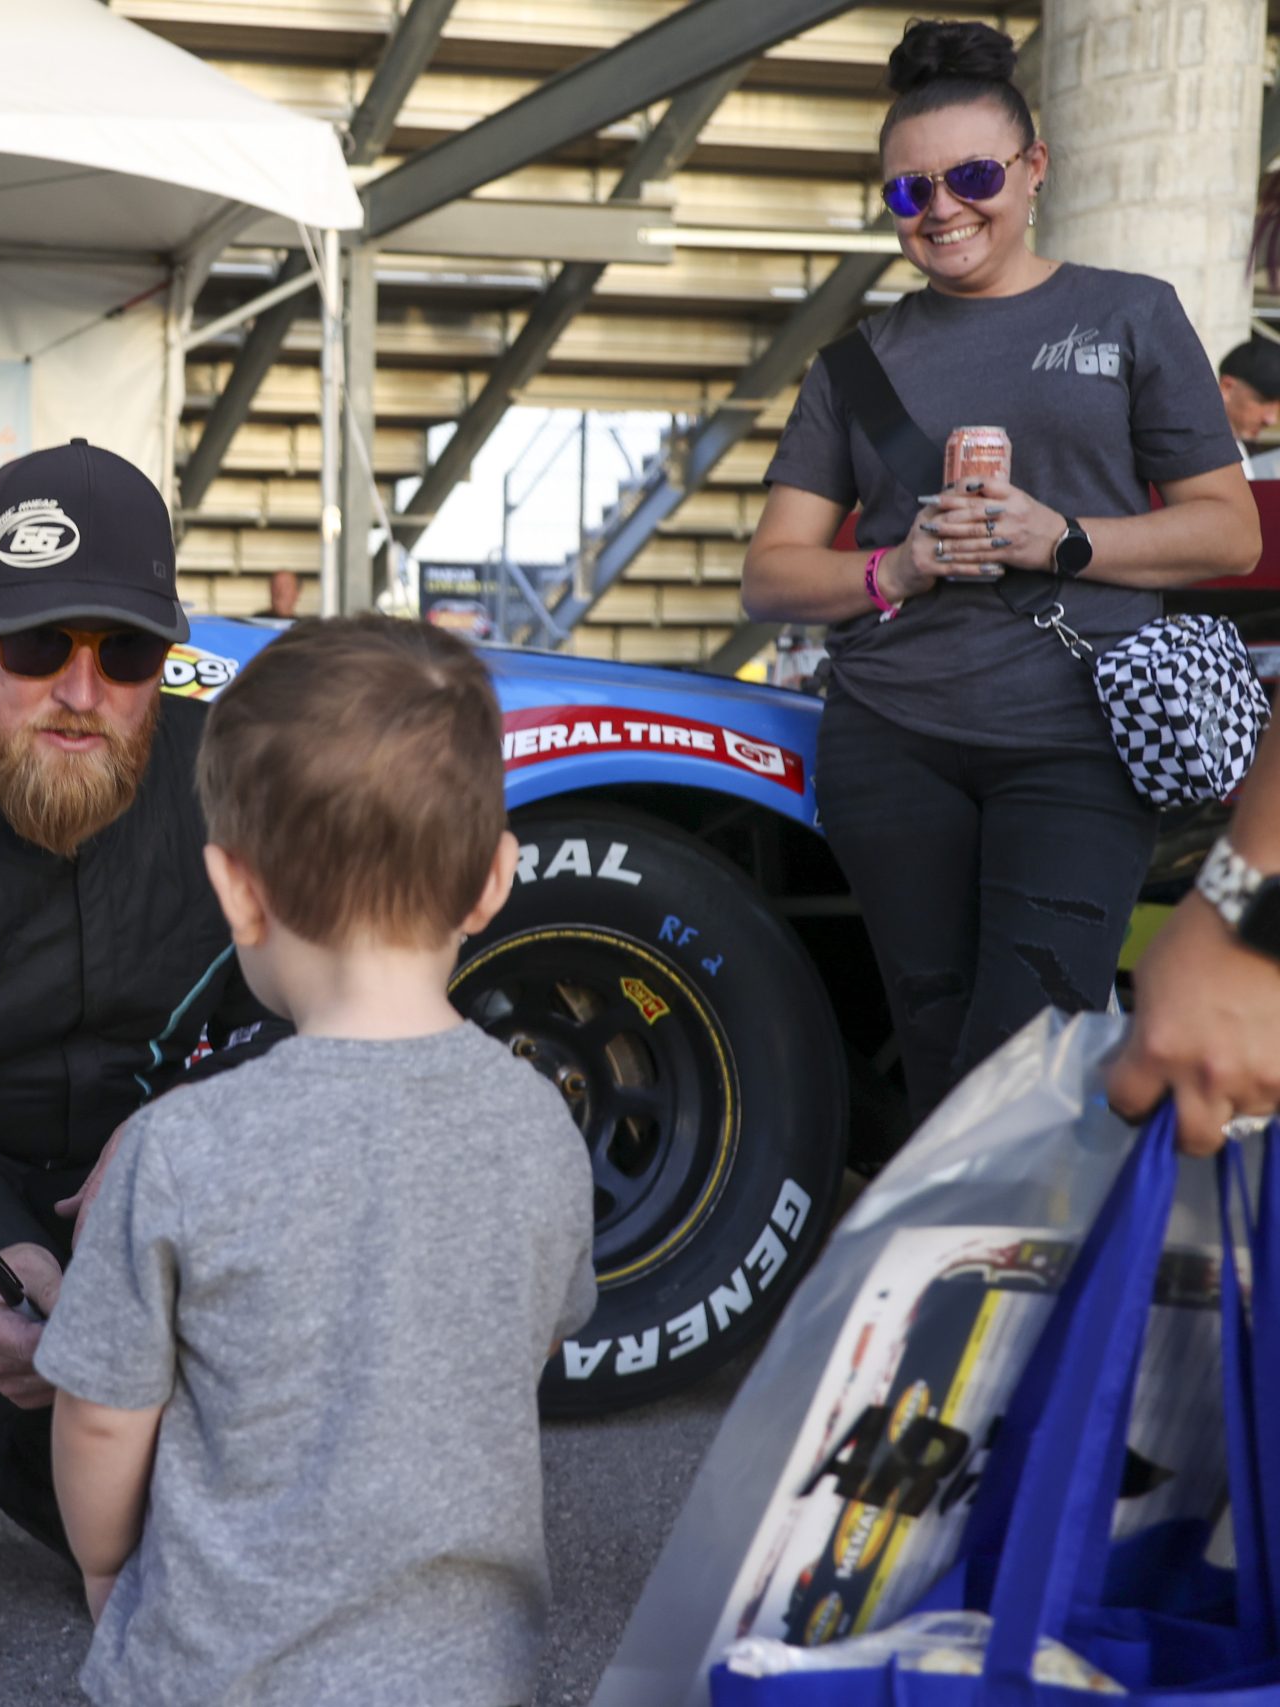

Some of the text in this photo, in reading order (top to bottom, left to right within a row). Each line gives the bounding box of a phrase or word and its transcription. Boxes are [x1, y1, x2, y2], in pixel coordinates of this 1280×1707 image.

[1074, 342, 1120, 377] 66
[10, 526, 65, 553] 66
[623, 721, 716, 751] TIRE
[658, 914, 699, 947] RF
[563, 1178, 812, 1380] GENERA
